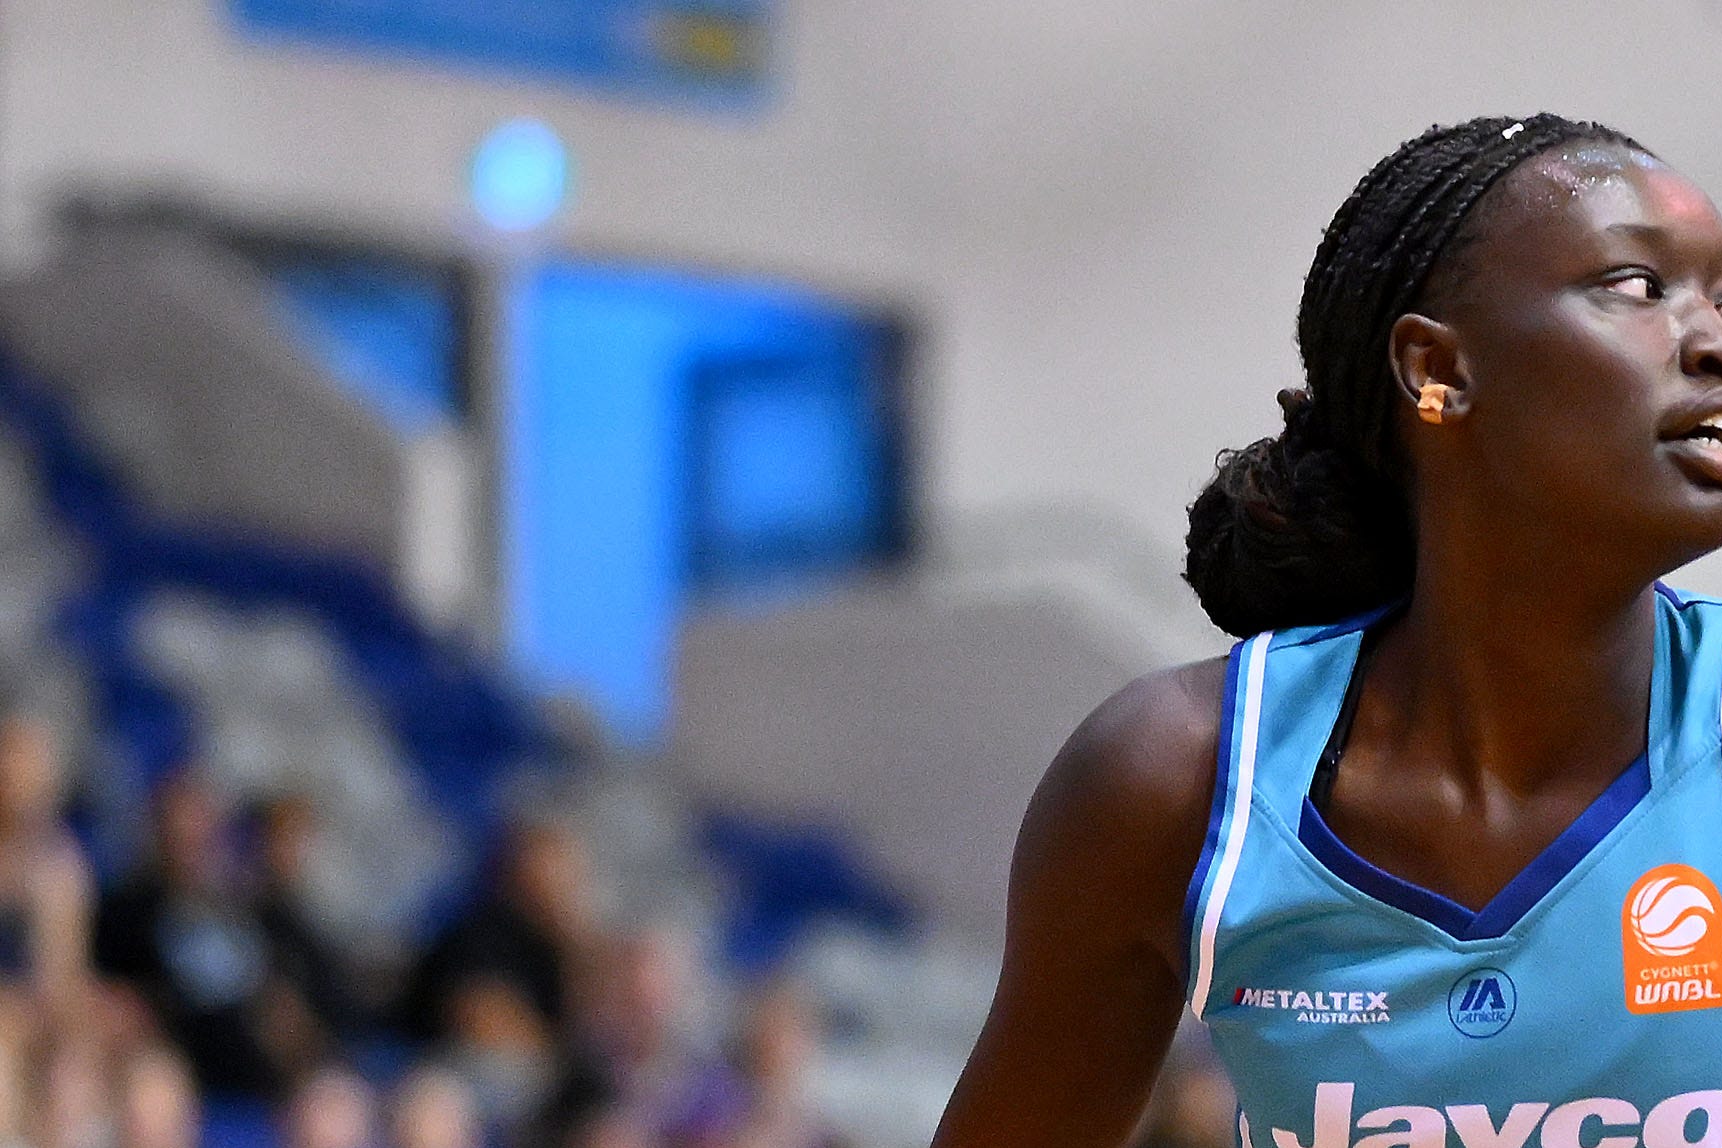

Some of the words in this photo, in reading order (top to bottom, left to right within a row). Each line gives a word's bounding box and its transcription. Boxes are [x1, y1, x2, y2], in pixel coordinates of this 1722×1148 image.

[1640, 963, 1710, 981] CYGNETT
[1240, 988, 1389, 1011] METALTEX
[1297, 1011, 1390, 1024] AUSTRALIA
